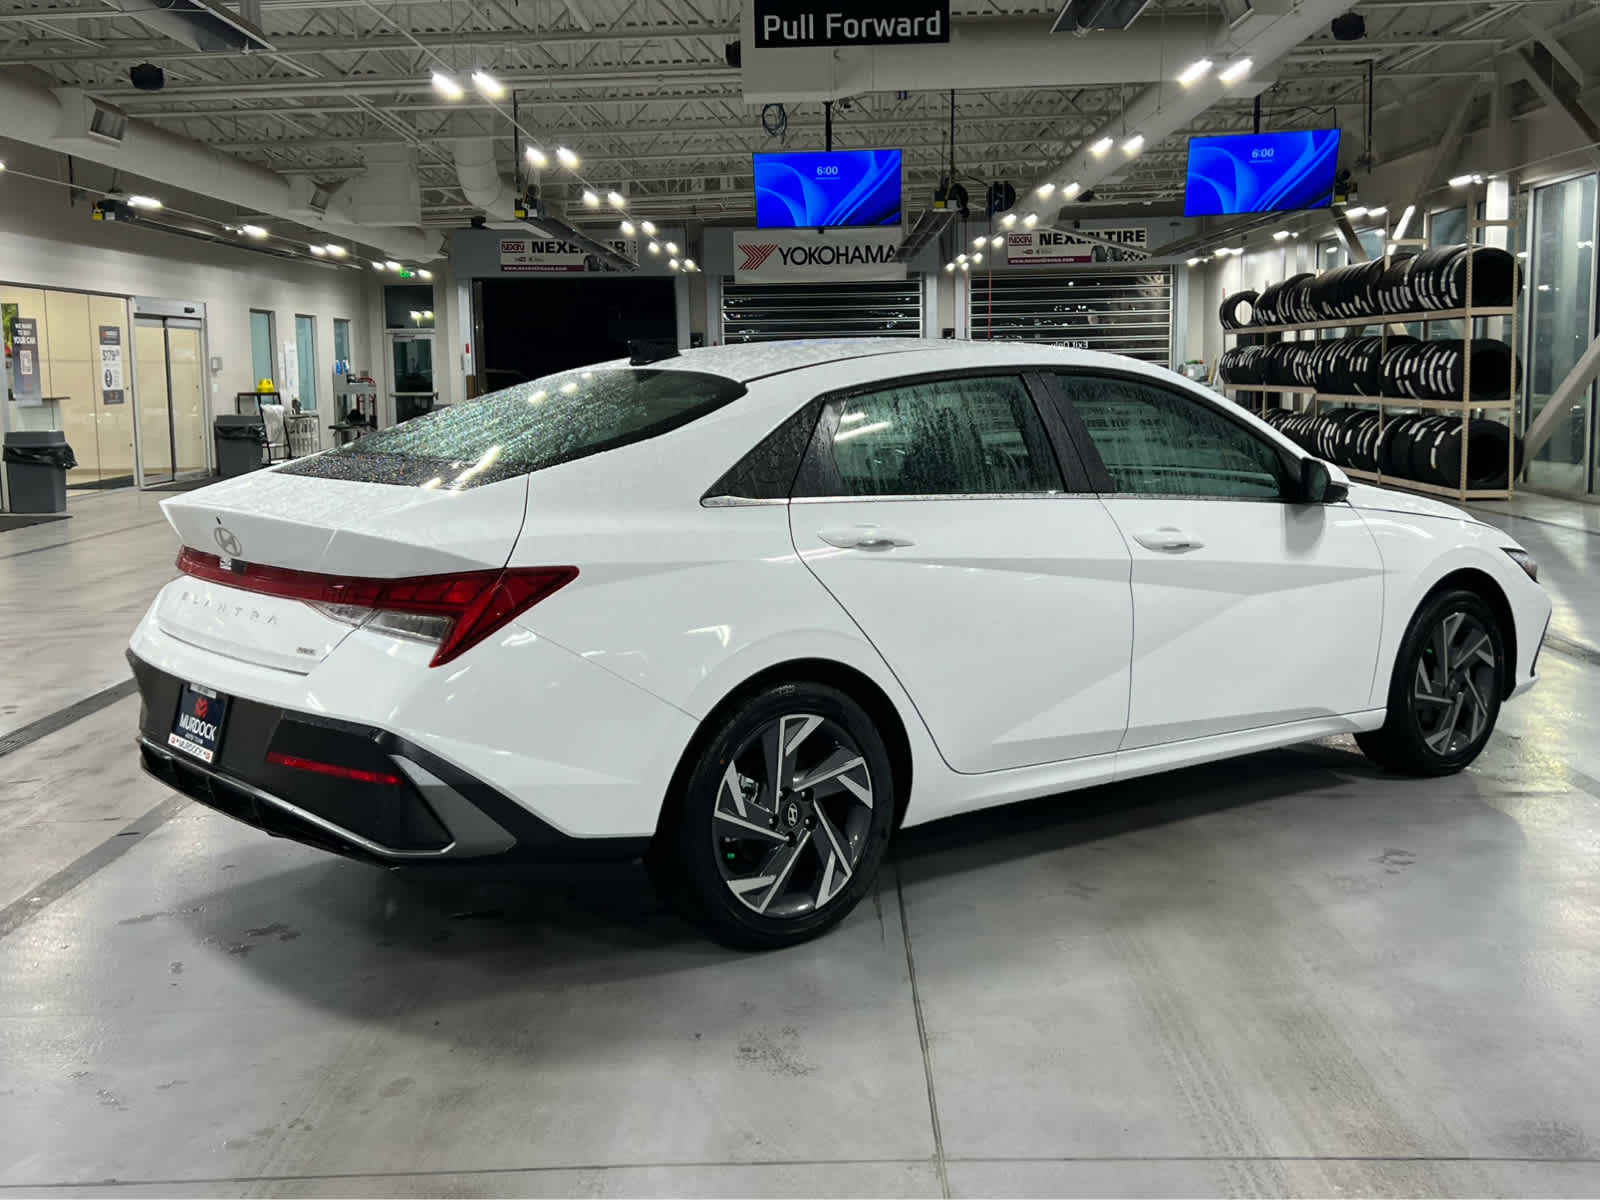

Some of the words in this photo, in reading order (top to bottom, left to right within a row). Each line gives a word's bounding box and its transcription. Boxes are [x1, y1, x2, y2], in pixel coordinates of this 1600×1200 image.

[763, 14, 814, 40] Pull
[826, 10, 941, 39] Forward
[1251, 147, 1274, 158] 6:00
[816, 165, 839, 176] 6:00
[1104, 230, 1146, 243] TIRE
[531, 240, 585, 254] NEXE
[778, 244, 897, 266] YOKOHAMA
[179, 712, 217, 742] MURDOCK
